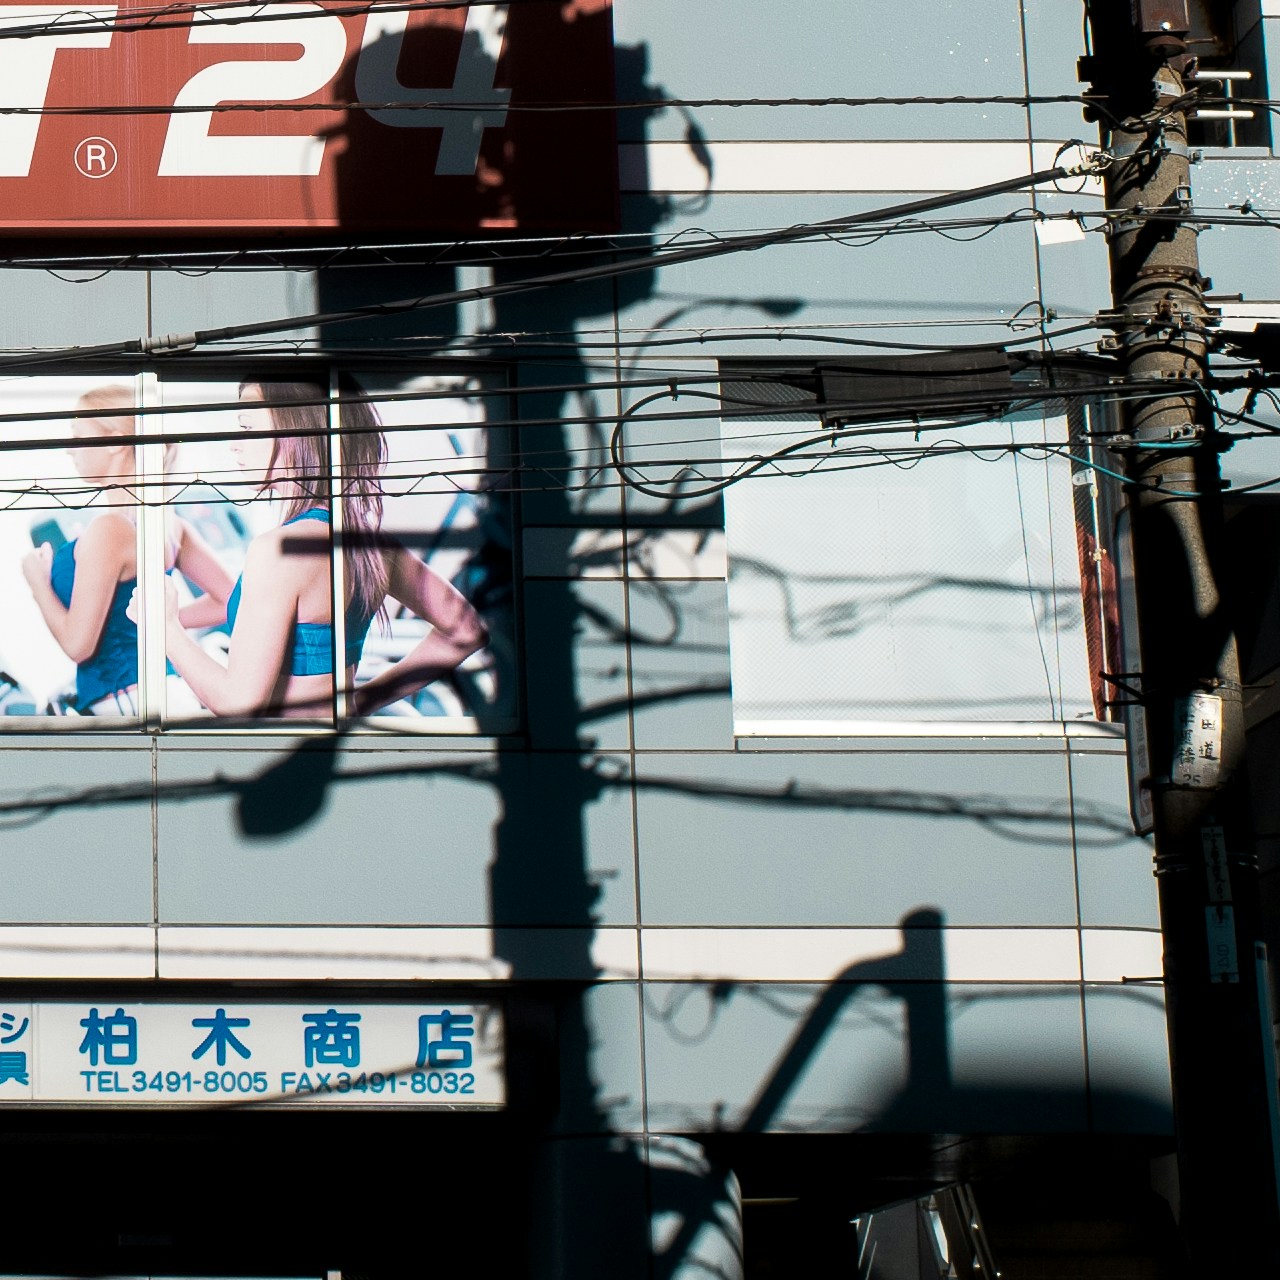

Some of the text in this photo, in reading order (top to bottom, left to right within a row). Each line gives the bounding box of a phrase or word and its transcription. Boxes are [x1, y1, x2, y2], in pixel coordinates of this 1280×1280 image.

[157, 3, 512, 178] 24
[78, 1007, 475, 1069] 柏木商店
